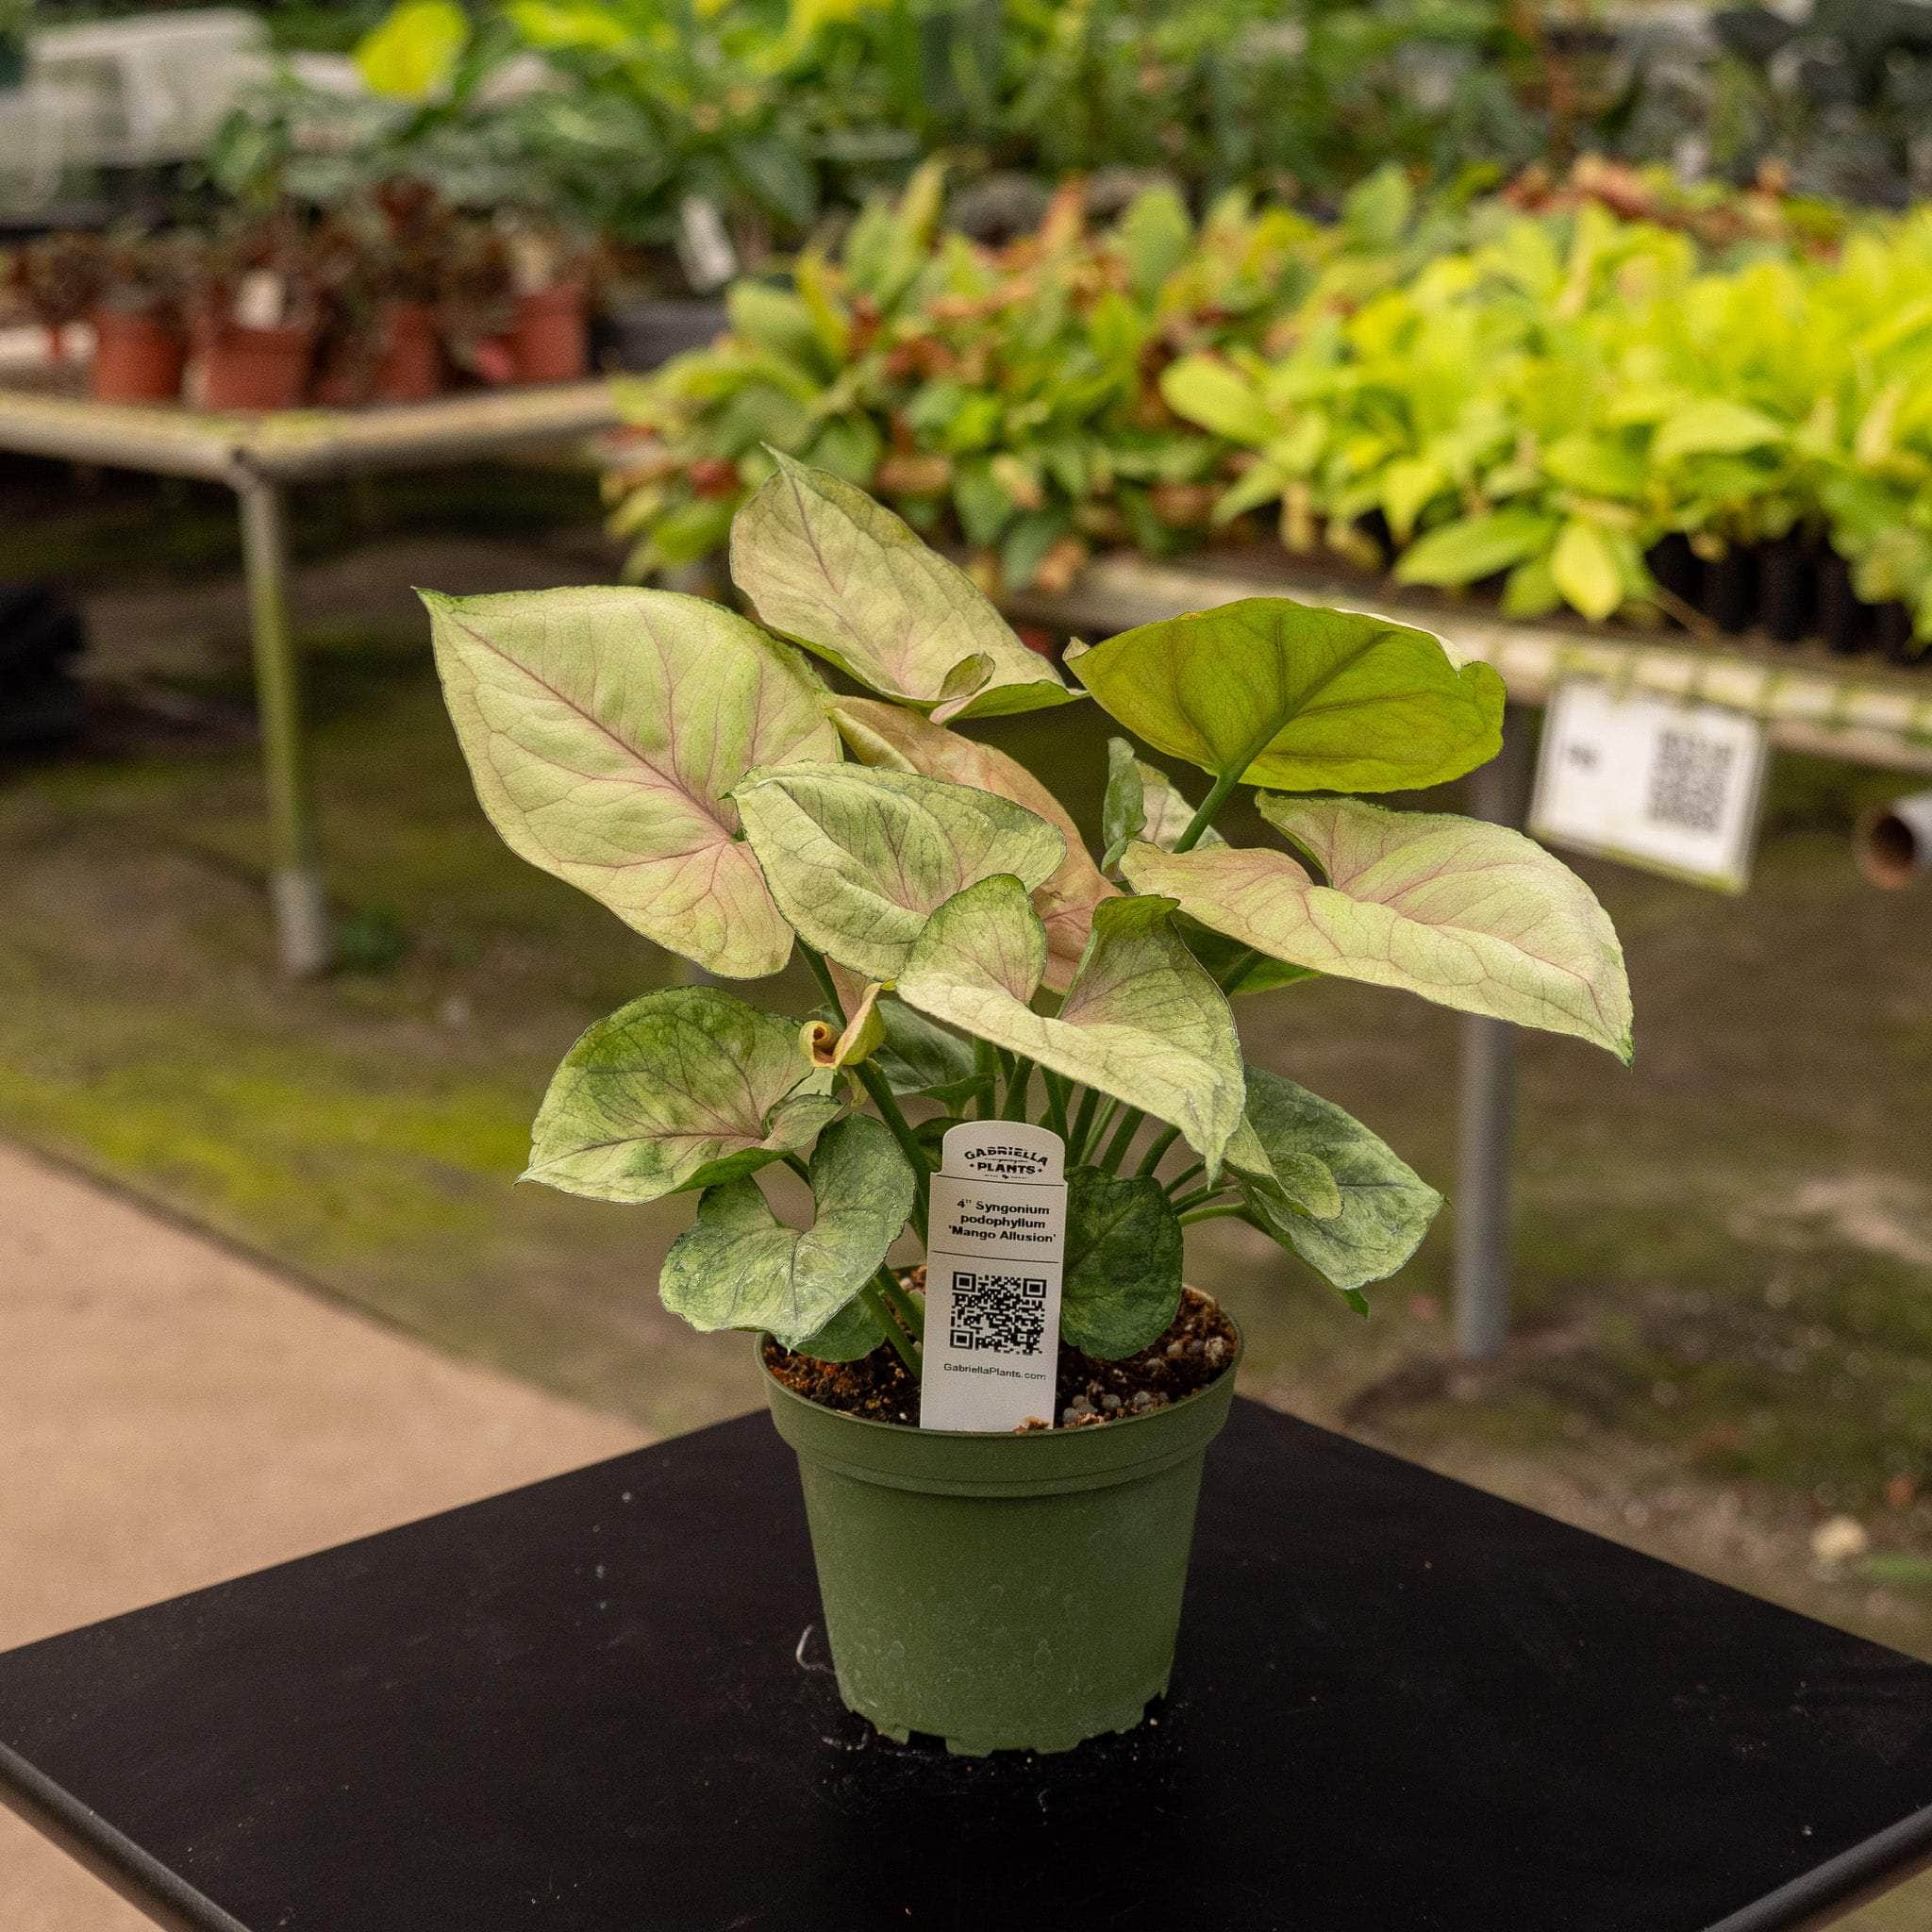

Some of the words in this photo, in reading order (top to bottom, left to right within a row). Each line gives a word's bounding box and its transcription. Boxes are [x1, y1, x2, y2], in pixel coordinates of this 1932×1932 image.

[964, 1146, 1048, 1167] GABRIELLA
[977, 1161, 1036, 1174] PLANTS
[975, 1201, 1050, 1215] Syngonium
[960, 1215, 1045, 1229] podophyllum
[949, 1225, 996, 1241] 'Mango
[999, 1231, 1057, 1242] Allusion'
[943, 1363, 1046, 1380] GabriellaPlants.com
